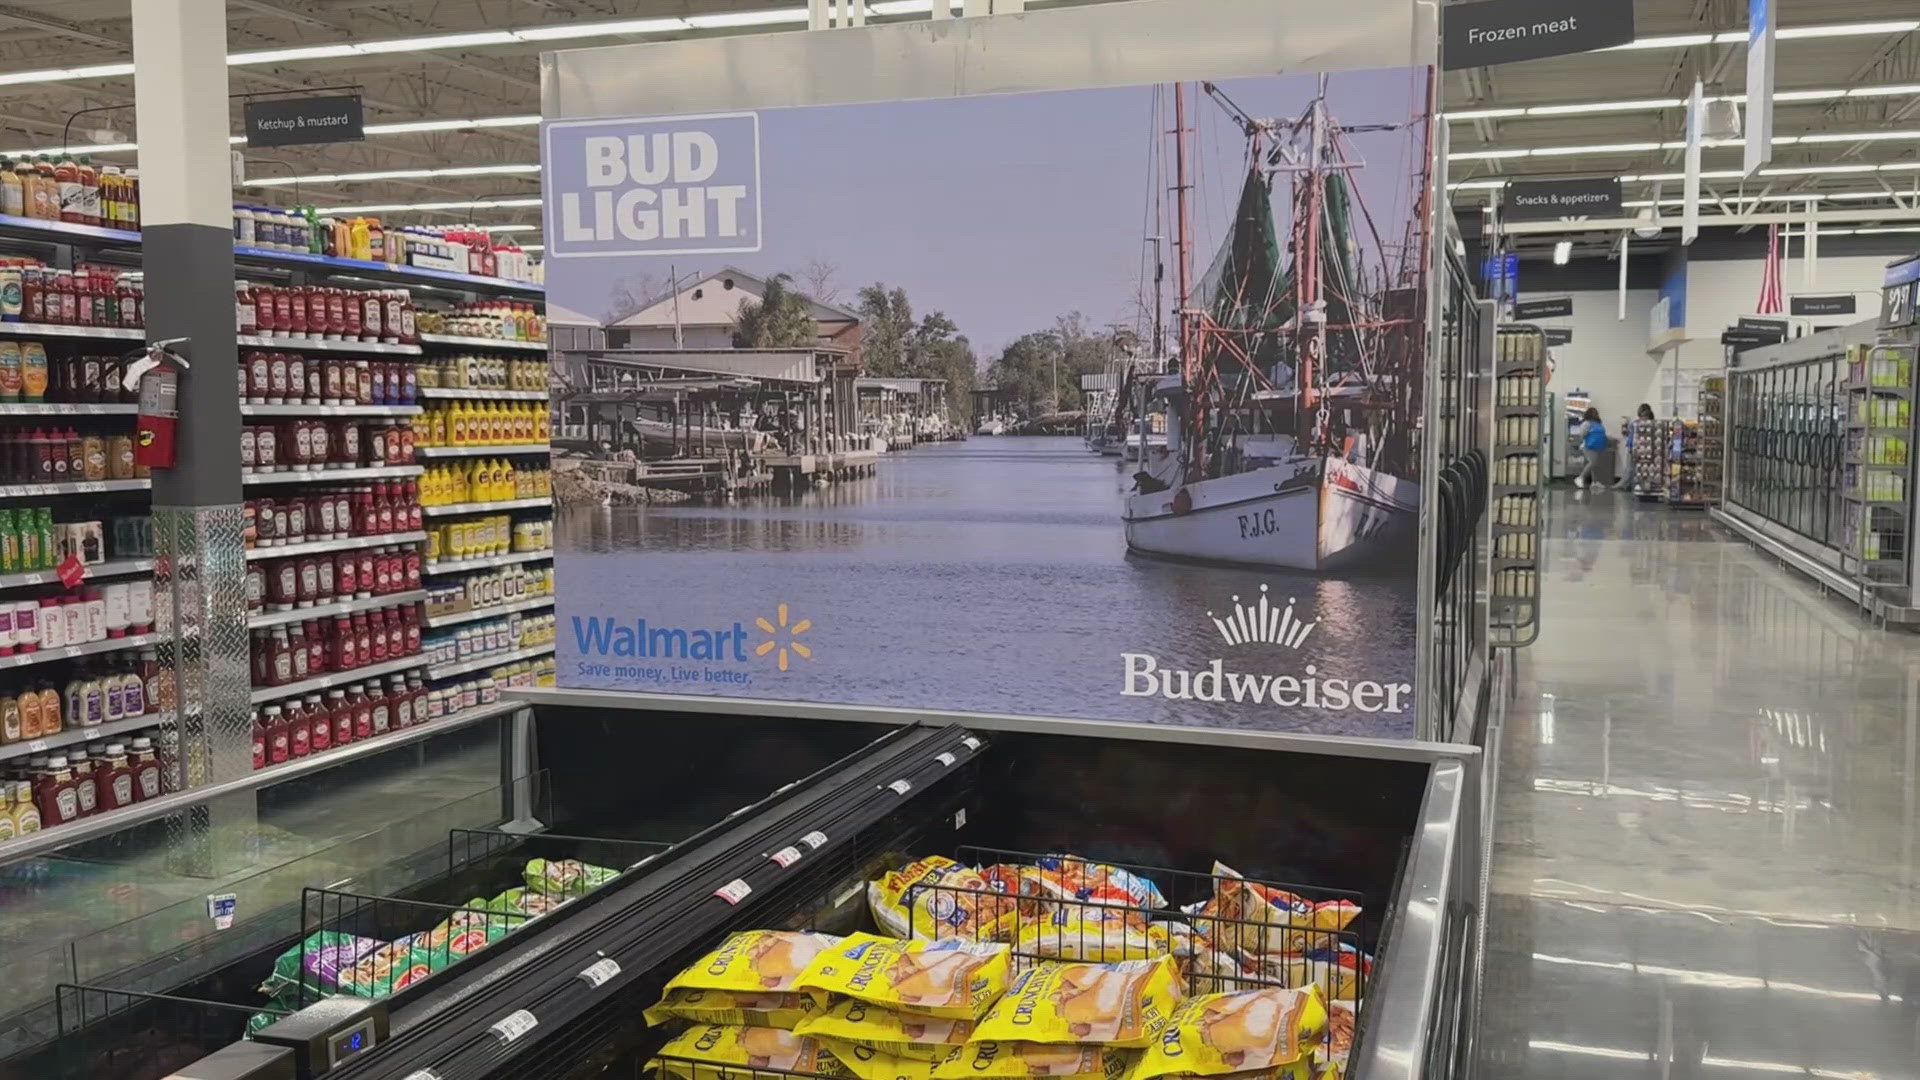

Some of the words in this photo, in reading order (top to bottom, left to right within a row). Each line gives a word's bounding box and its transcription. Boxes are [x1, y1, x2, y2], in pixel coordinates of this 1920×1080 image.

[1468, 25, 1527, 44] Frozen
[1532, 16, 1577, 36] meat
[257, 118, 296, 131] Ketchup
[297, 115, 305, 128] &
[307, 113, 349, 127] mustard
[584, 130, 720, 188] BUD
[561, 185, 747, 243] LIGHT
[1516, 195, 1549, 206] Snacks
[1550, 194, 1559, 204] &
[1560, 192, 1610, 206] appetizers
[1237, 508, 1280, 540] F.J.G.
[572, 615, 748, 662] Walmart
[578, 661, 610, 678] Save
[615, 666, 667, 682] money.
[671, 666, 700, 681] Live
[1120, 652, 1412, 714] Budweiser
